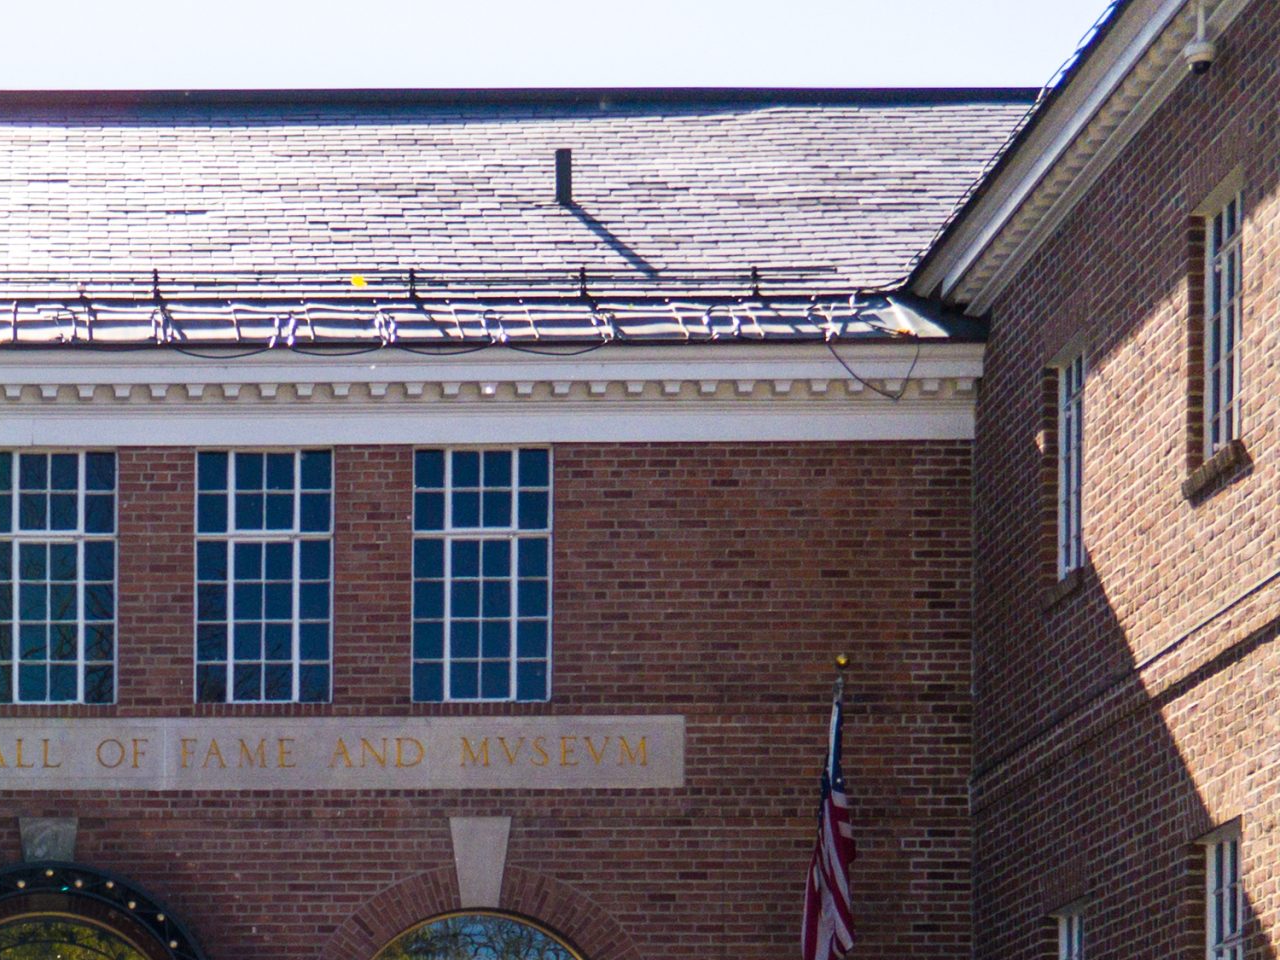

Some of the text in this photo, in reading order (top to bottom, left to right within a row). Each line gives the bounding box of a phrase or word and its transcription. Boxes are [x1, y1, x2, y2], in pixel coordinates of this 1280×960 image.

[95, 737, 149, 769] OF
[179, 737, 297, 769] FAME
[327, 736, 426, 769] AND
[459, 735, 649, 768] MVSEVM
